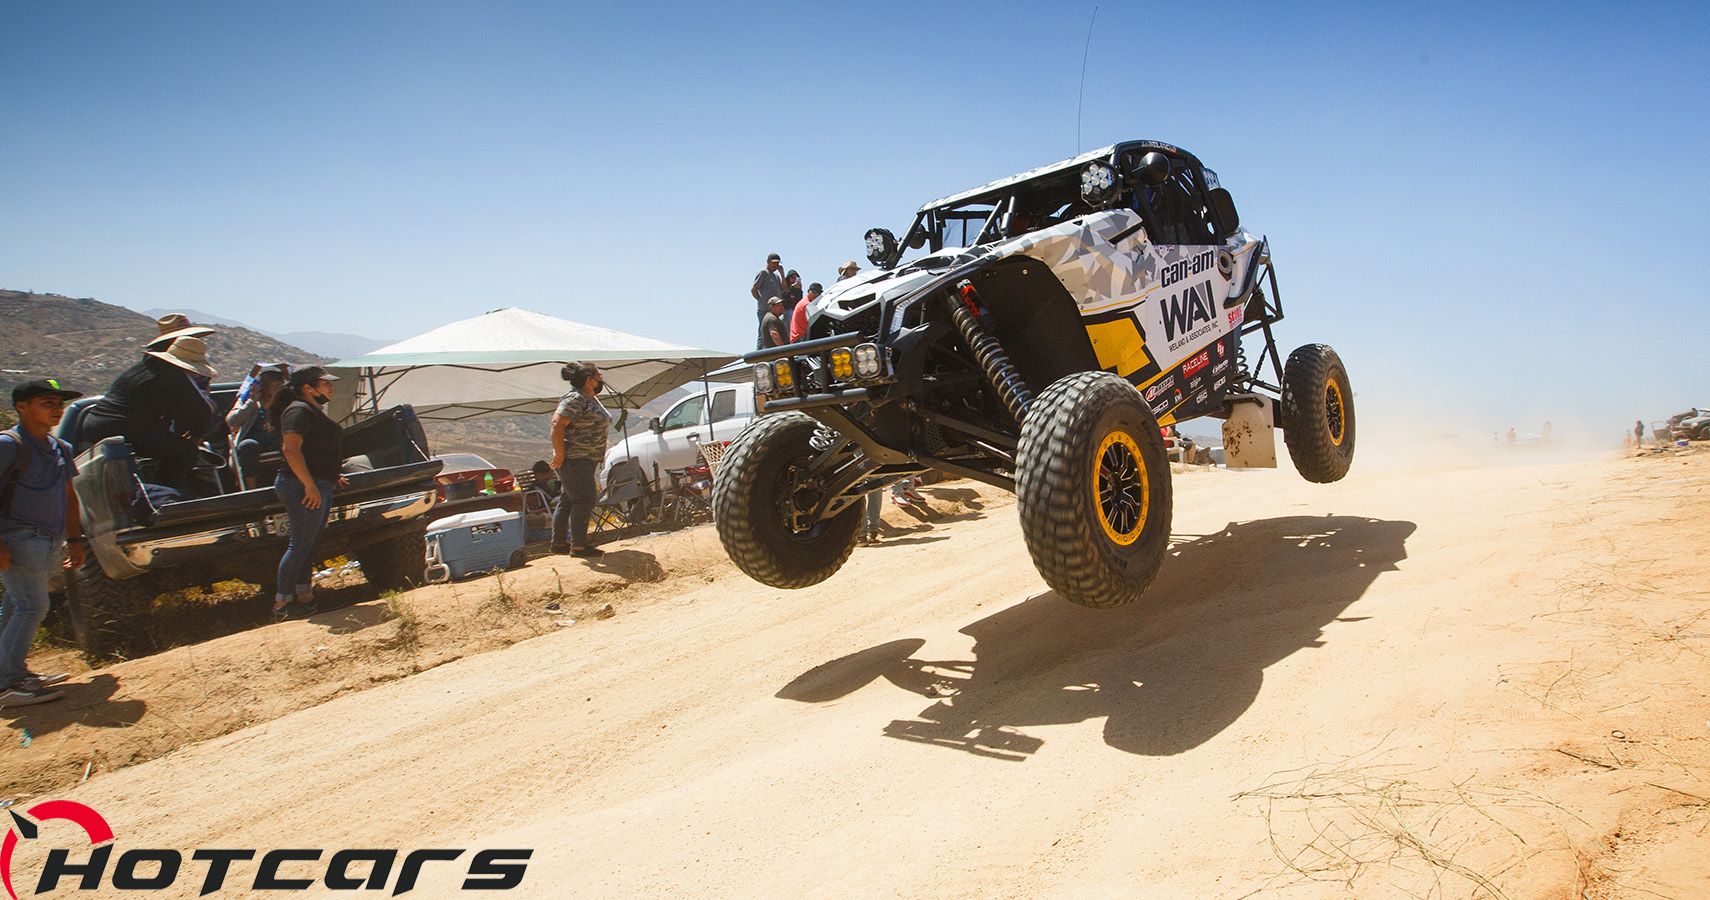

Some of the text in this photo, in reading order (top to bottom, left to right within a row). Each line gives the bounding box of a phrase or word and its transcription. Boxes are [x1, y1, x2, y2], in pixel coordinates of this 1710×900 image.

[1161, 250, 1214, 288] can-am
[1160, 280, 1217, 342] WAI
[1182, 351, 1209, 374] RACELINE
